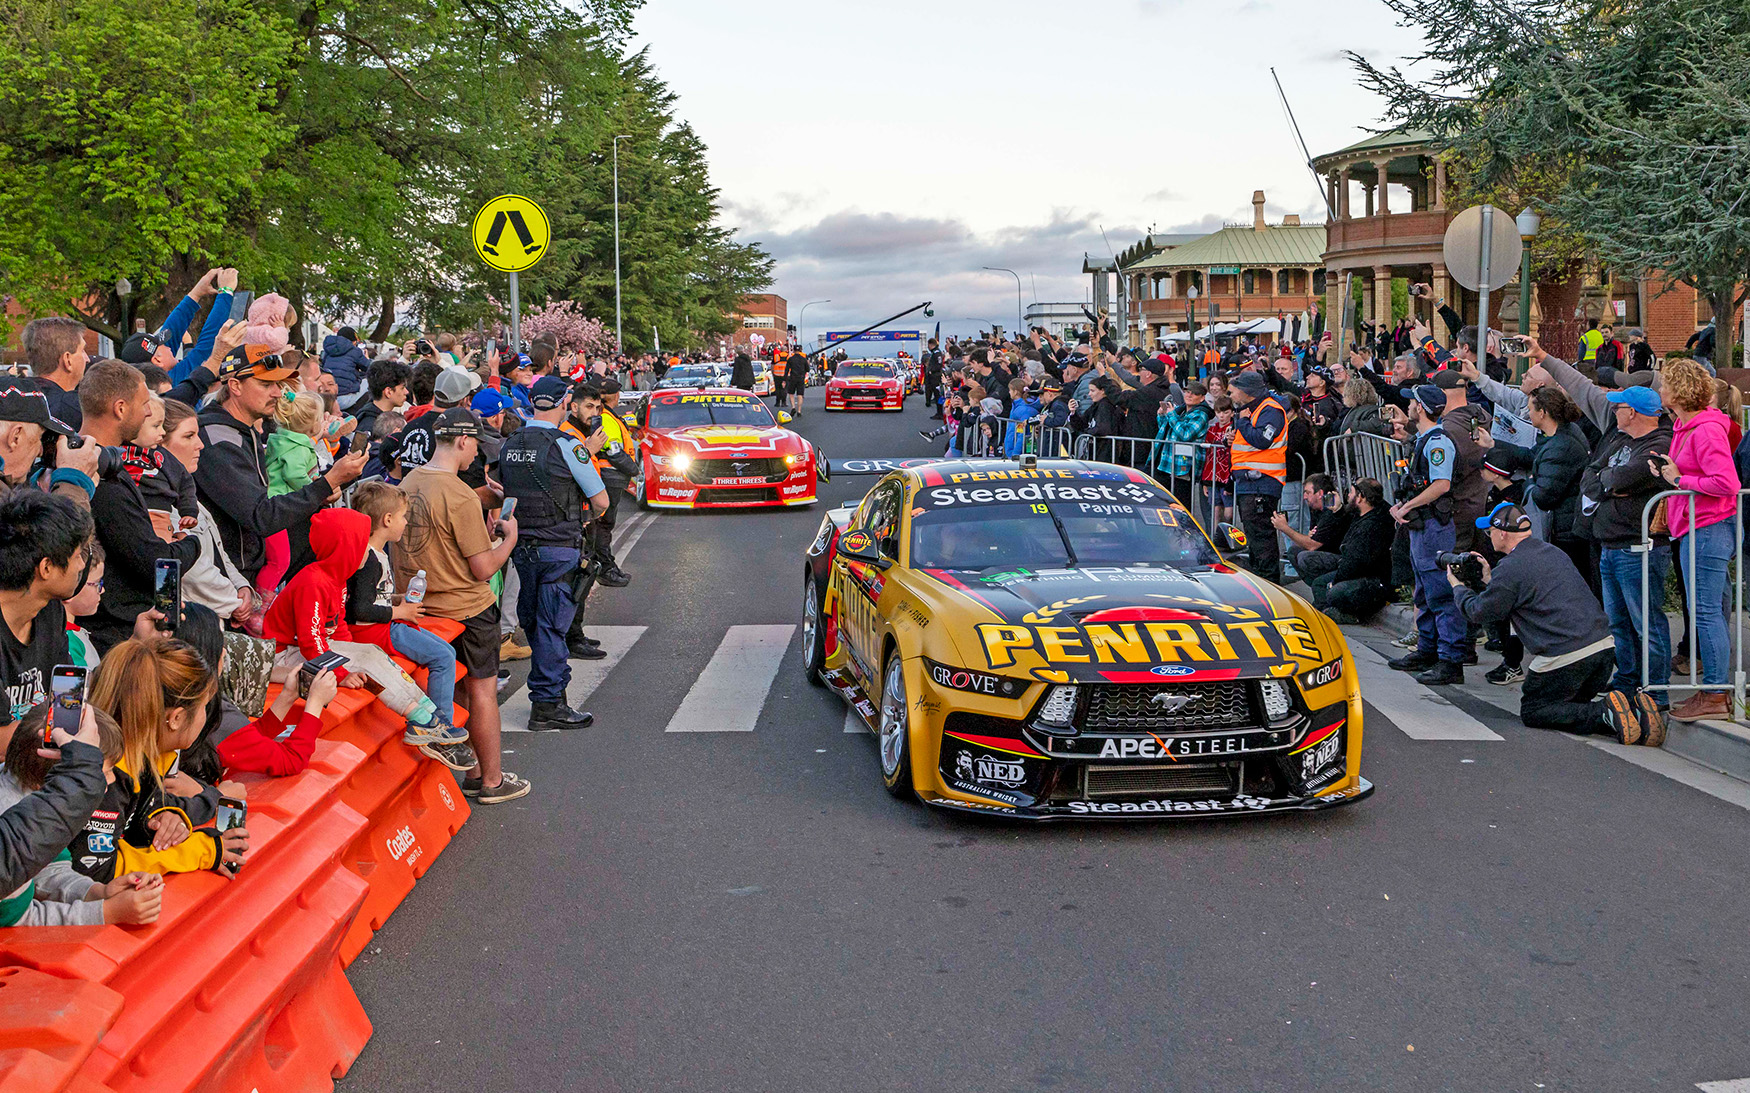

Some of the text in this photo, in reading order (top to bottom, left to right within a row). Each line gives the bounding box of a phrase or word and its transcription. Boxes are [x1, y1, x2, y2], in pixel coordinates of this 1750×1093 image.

[681, 395, 750, 404] PIRTEK
[506, 452, 537, 462] POLICE
[950, 469, 1075, 483] PENRITE
[667, 487, 694, 498] Repco
[930, 483, 1118, 506] Steadfast
[1030, 502, 1134, 515] 19 Payne
[843, 535, 872, 547] PENRITE
[911, 607, 930, 629] FISHER
[977, 618, 1321, 668] PENRITE
[1100, 734, 1250, 761] APEX STEEL
[1315, 736, 1339, 767] NED
[977, 761, 1026, 781] NED
[954, 780, 1018, 803] AUSTRALIAN WHISKY
[1067, 799, 1225, 814] Steadfast
[91, 820, 116, 830] TOYOTA
[386, 825, 416, 861] Coates
